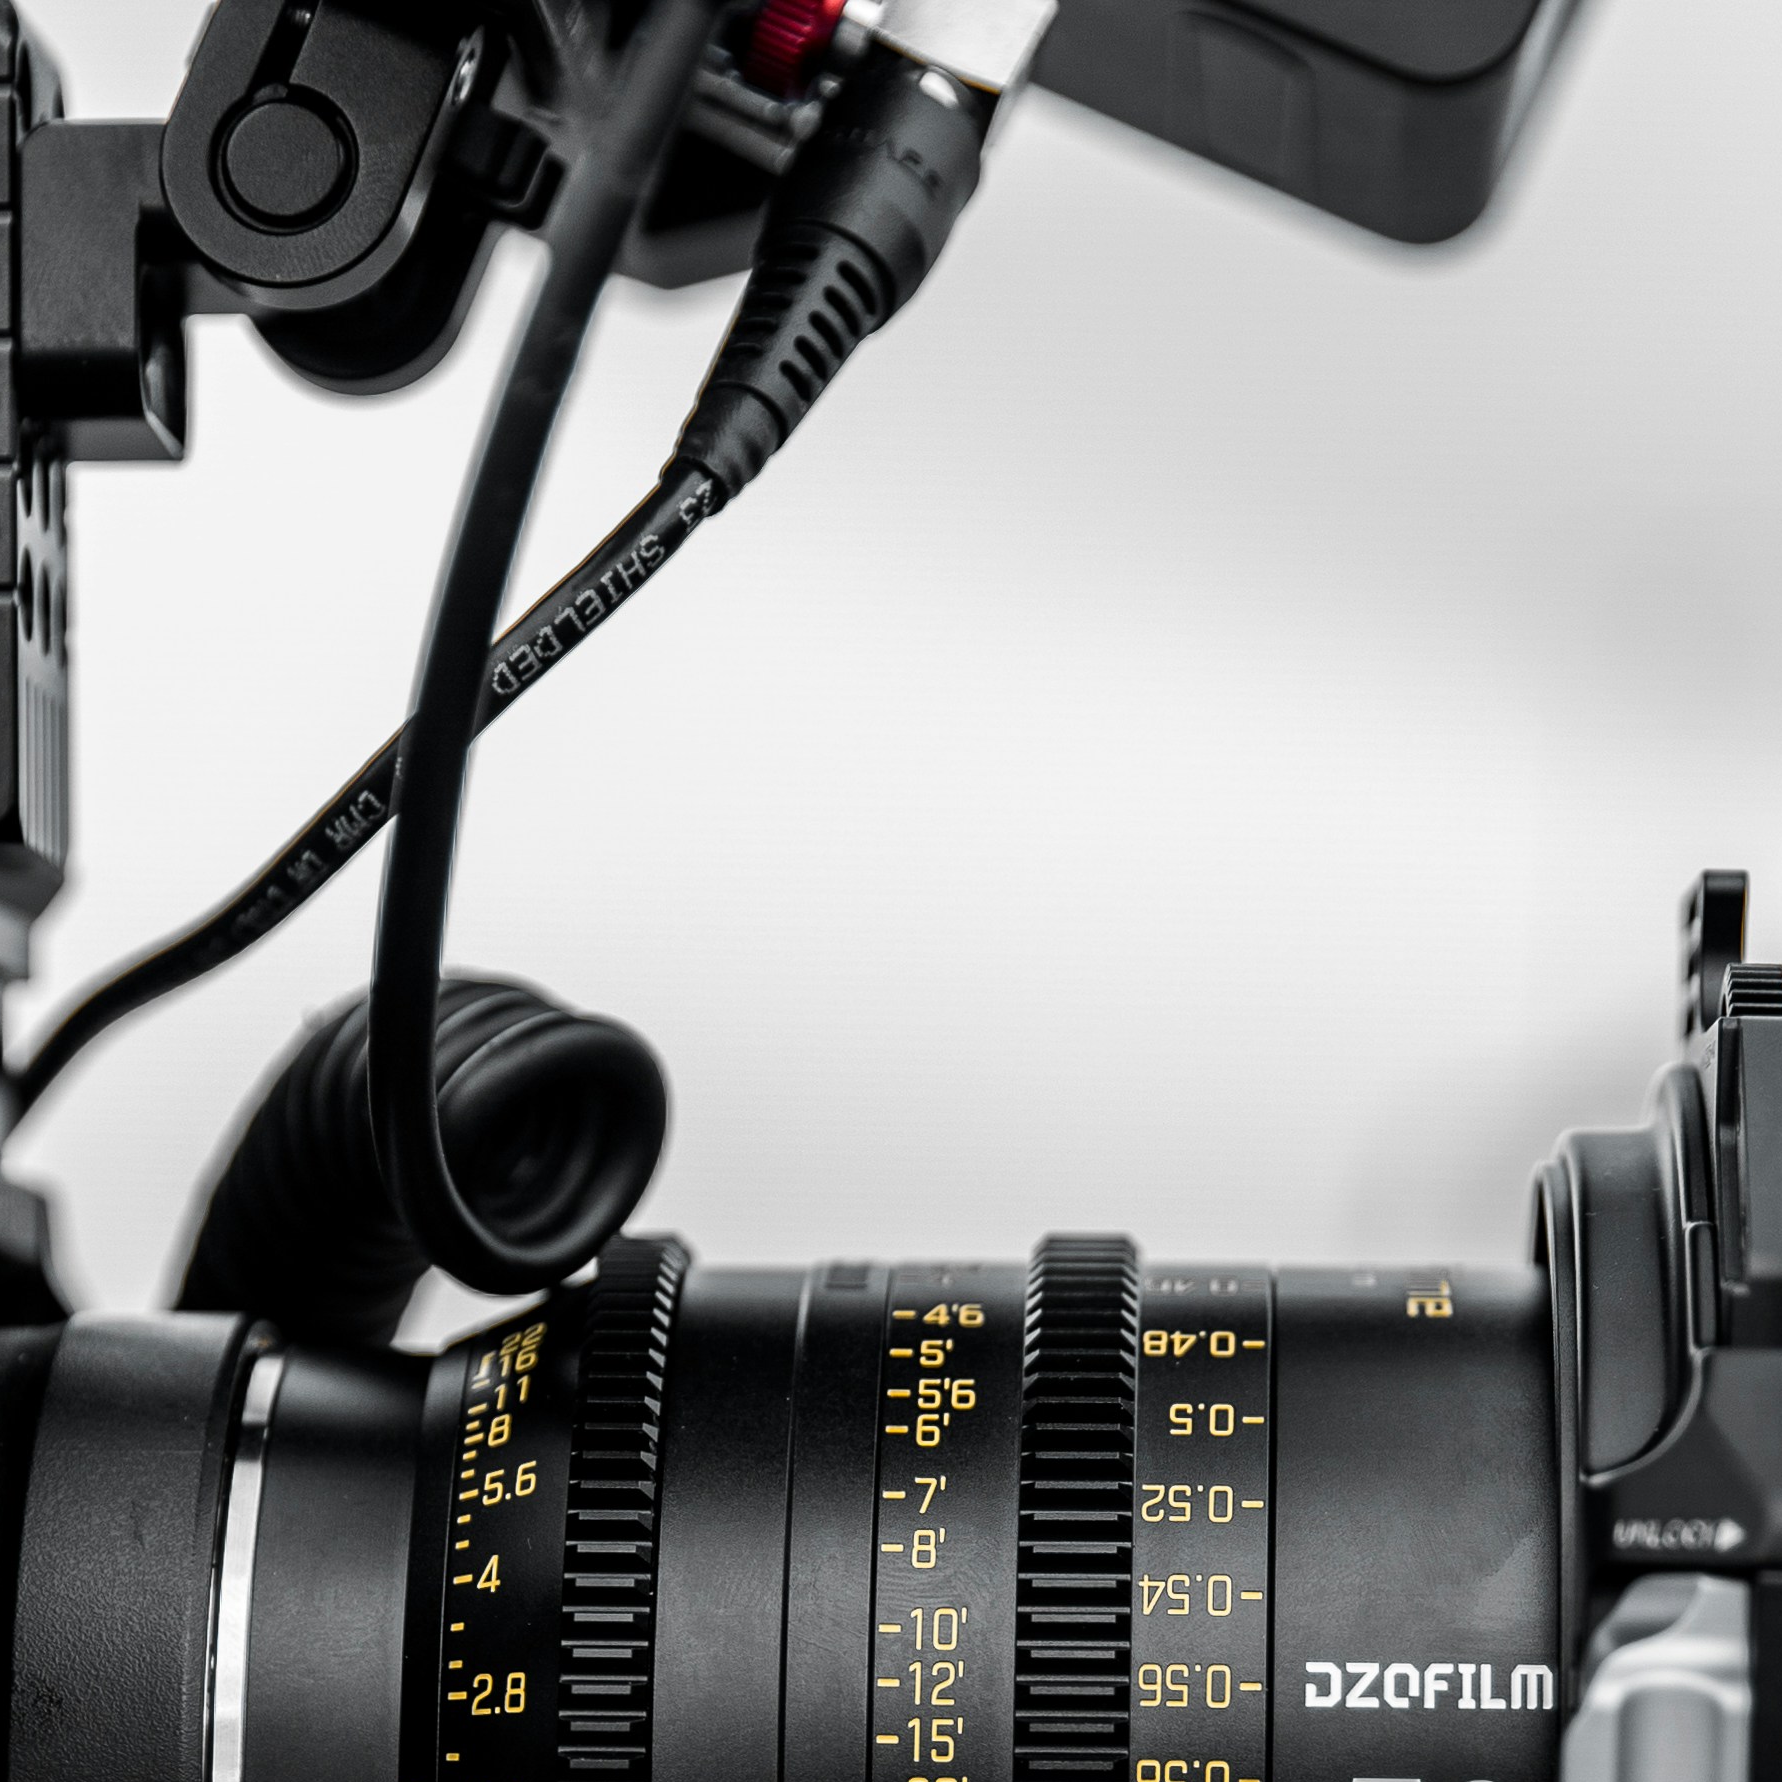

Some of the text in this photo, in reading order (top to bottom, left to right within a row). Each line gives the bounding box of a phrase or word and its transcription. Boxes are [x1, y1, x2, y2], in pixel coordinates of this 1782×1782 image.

[491, 533, 666, 697] SHIELDED
[499, 1321, 547, 1356] 22
[919, 1339, 954, 1368] 5'
[1142, 1329, 1237, 1358] 0.48
[498, 1343, 539, 1378] 16
[494, 1374, 531, 1412] 11
[917, 1379, 977, 1410] 5'6
[487, 1413, 512, 1448] 8
[915, 1413, 951, 1448] 6'
[1168, 1404, 1235, 1437] 0.5
[482, 1460, 538, 1507] 5.6
[916, 1476, 947, 1514] 7'
[1141, 1485, 1235, 1523] 0.52
[910, 1527, 947, 1569] 8'
[476, 1554, 502, 1593] 4
[1138, 1574, 1233, 1616] 0.54
[909, 1607, 968, 1651] 10'
[471, 1671, 526, 1716] 2.8
[908, 1661, 967, 1706] 12'
[1137, 1663, 1232, 1708] 0.56
[1304, 1661, 1554, 1710] DZOFILM
[907, 1716, 965, 1763] 15'
